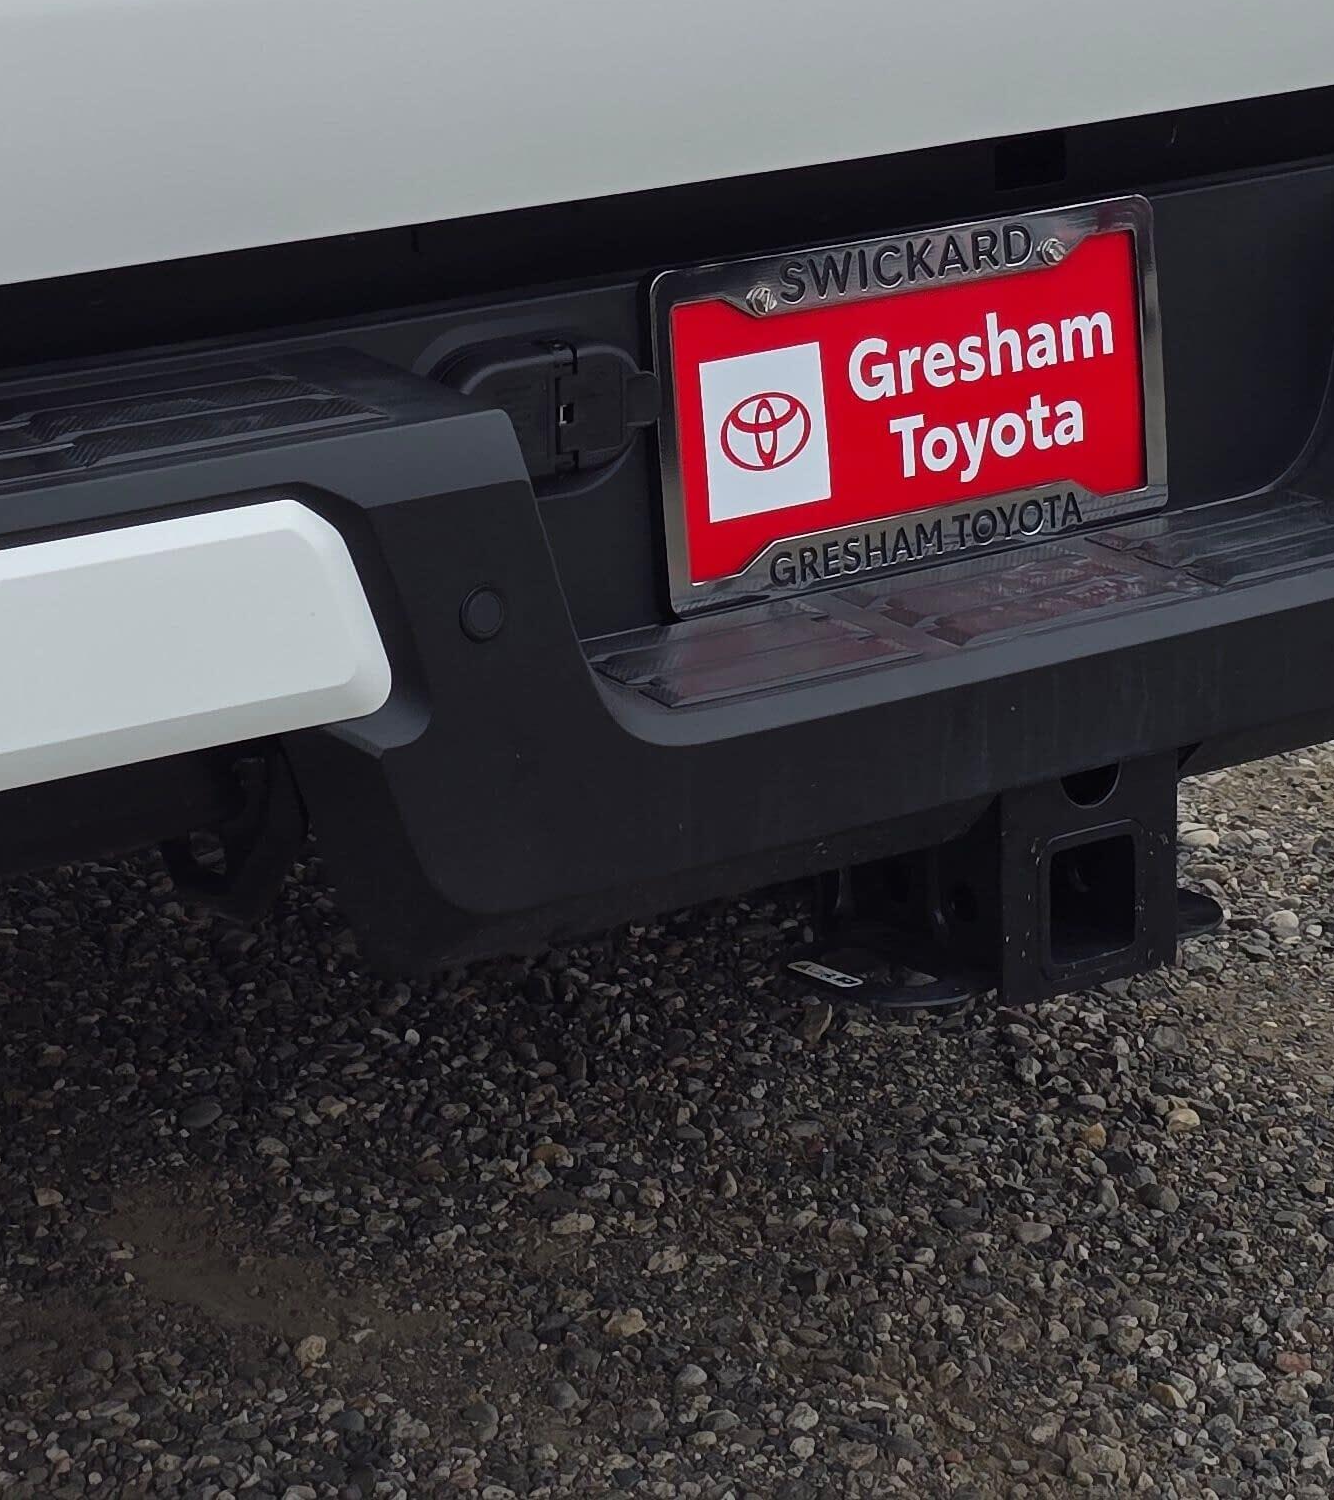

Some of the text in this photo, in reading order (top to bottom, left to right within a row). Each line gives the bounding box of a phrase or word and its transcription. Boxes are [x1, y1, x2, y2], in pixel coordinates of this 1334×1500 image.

[779, 223, 1033, 304] SWICKARD
[847, 310, 1114, 402] Gresham
[889, 394, 1085, 483] Toyota
[769, 491, 1084, 588] GRESHAM TOYOTA
